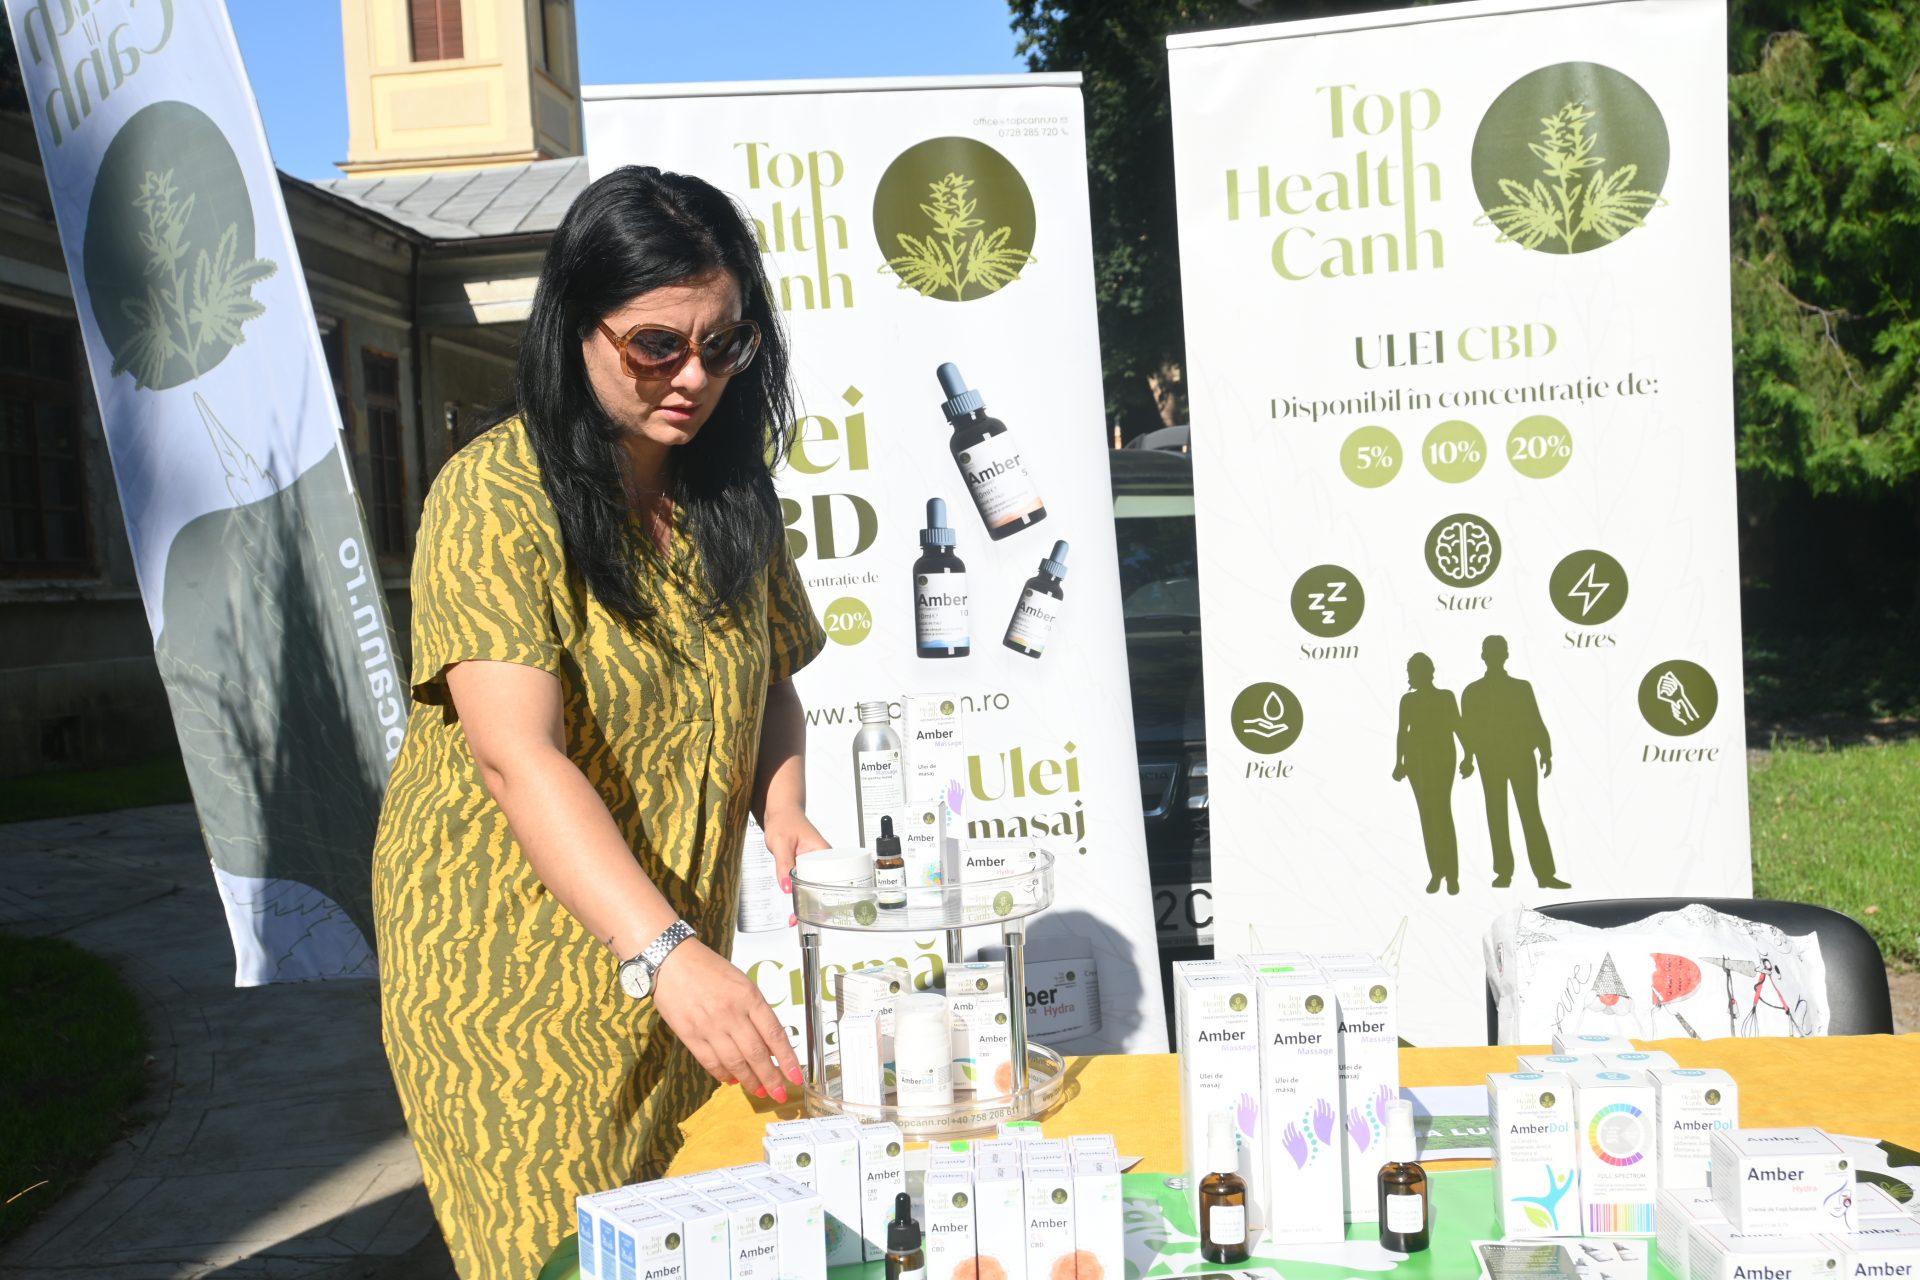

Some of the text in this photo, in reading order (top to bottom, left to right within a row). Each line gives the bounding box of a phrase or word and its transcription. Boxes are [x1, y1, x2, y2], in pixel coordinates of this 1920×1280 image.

[1316, 83, 1442, 139] Top
[1042, 127, 1058, 136] 720
[733, 141, 844, 189] Top
[1225, 149, 1442, 221] Health
[1354, 322, 1558, 370] ULEI CBD
[1270, 389, 1402, 423] Disponibil
[1616, 371, 1660, 397] de:
[1428, 438, 1481, 466] 10%
[1511, 434, 1572, 461] 20%
[1355, 445, 1393, 470] 5%
[967, 454, 1021, 485] Amber
[862, 572, 879, 584] de
[918, 593, 968, 607] Amber
[1435, 592, 1493, 611] Stare
[1020, 601, 1056, 623] Amber
[826, 611, 871, 632] 20%
[1563, 631, 1616, 650] Stres
[1299, 642, 1360, 661] Somn
[916, 729, 953, 741] Amber
[1642, 743, 1720, 763] Durere
[860, 762, 892, 772] Amber
[967, 740, 1080, 801] Ulei
[1245, 760, 1294, 780] Piele
[967, 799, 1086, 845] masaj
[907, 834, 934, 842] Amber
[966, 856, 1006, 868] Amber
[953, 1002, 974, 1010] Amb
[1043, 1004, 1075, 1018] Hydra
[1337, 1020, 1385, 1034] Amber
[979, 1035, 1007, 1043] Amber
[1198, 1029, 1246, 1042] Amber
[1273, 1032, 1322, 1045] Amber
[1361, 1035, 1396, 1043] Massage
[1221, 1043, 1257, 1052] Massage
[1297, 1047, 1333, 1056] Massage
[971, 1112, 987, 1122] 758
[990, 1110, 1005, 1120] 208
[1450, 1127, 1489, 1136] LU
[1510, 1121, 1569, 1135] AmberDol
[1673, 1119, 1733, 1131] AmberDol
[866, 1169, 901, 1182] Amber
[1747, 1166, 1805, 1181] Amber
[931, 1221, 969, 1233] Amber
[1030, 1218, 1068, 1229] Amber
[739, 1245, 775, 1259] Amber
[645, 1265, 681, 1280] Amber
[1733, 1265, 1792, 1280] Amber
[1854, 1262, 1912, 1278] Amber
